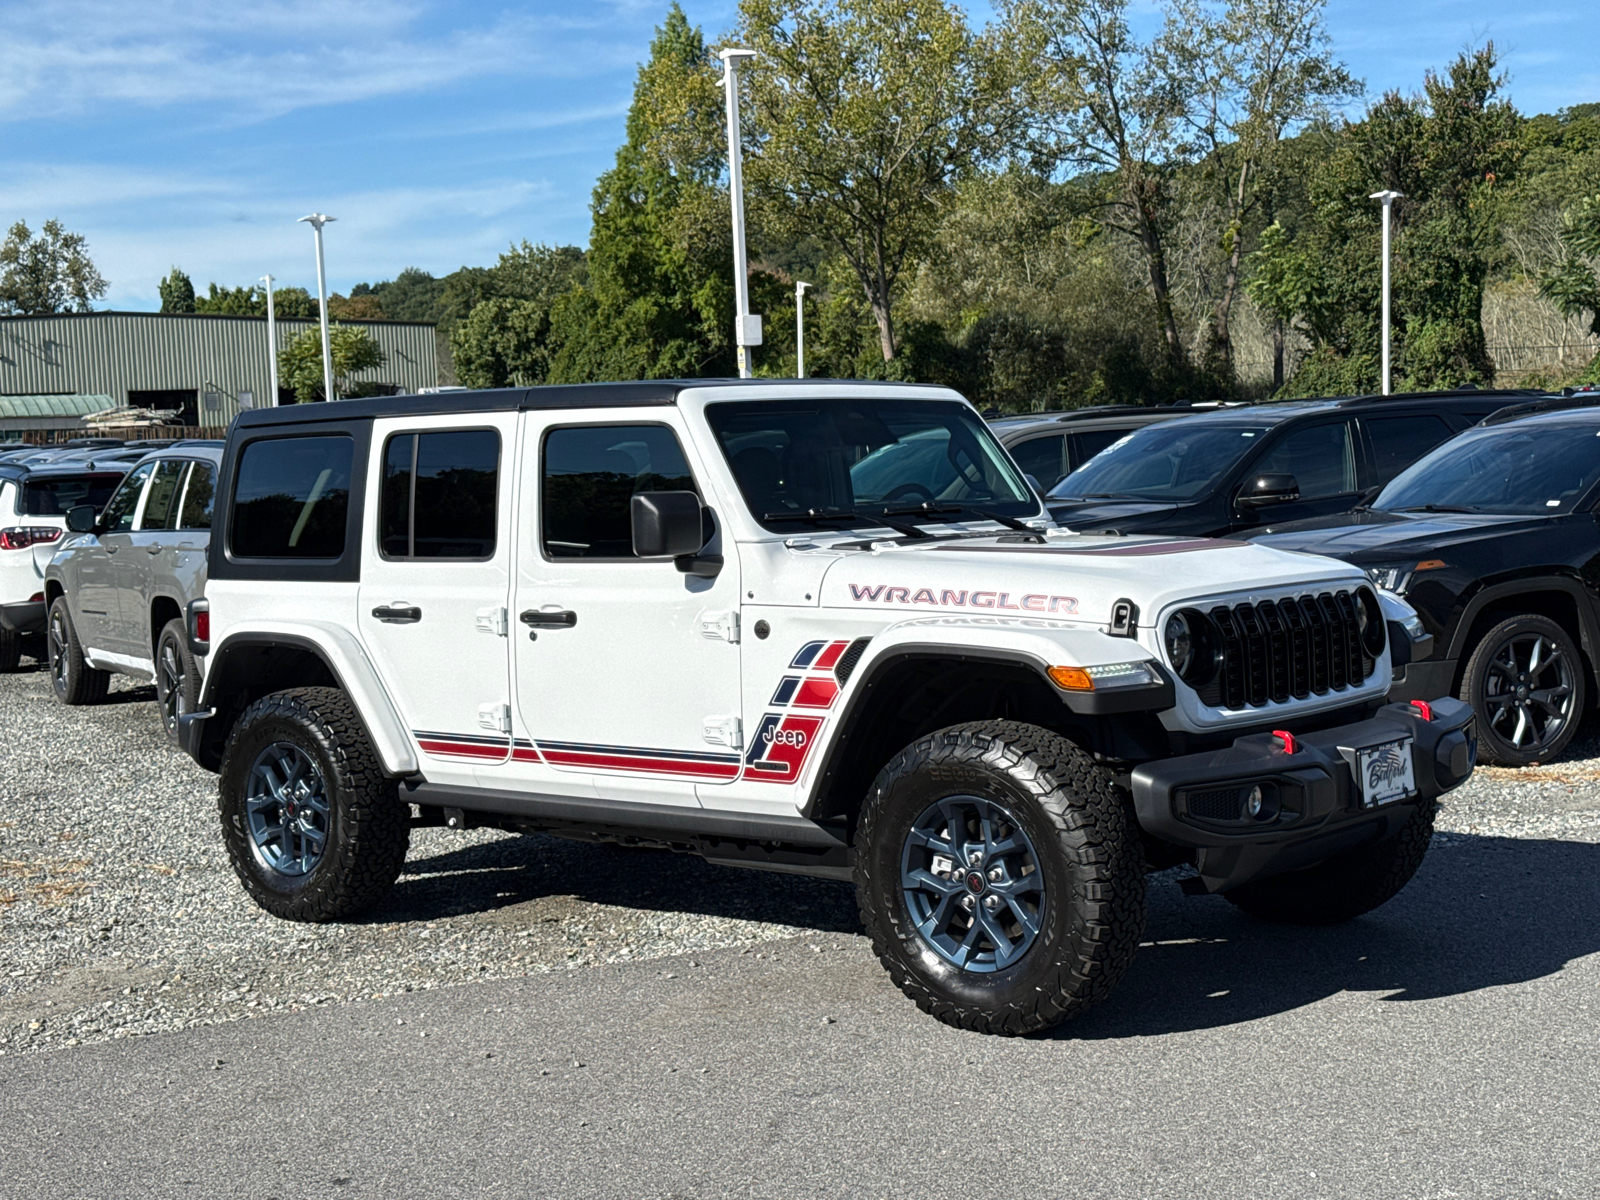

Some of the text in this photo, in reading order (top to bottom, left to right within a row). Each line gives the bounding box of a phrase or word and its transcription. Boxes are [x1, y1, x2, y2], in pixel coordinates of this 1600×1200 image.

[848, 583, 1080, 615] WRANGLER
[762, 725, 807, 749] Jeep
[1367, 758, 1407, 789] Bedford
